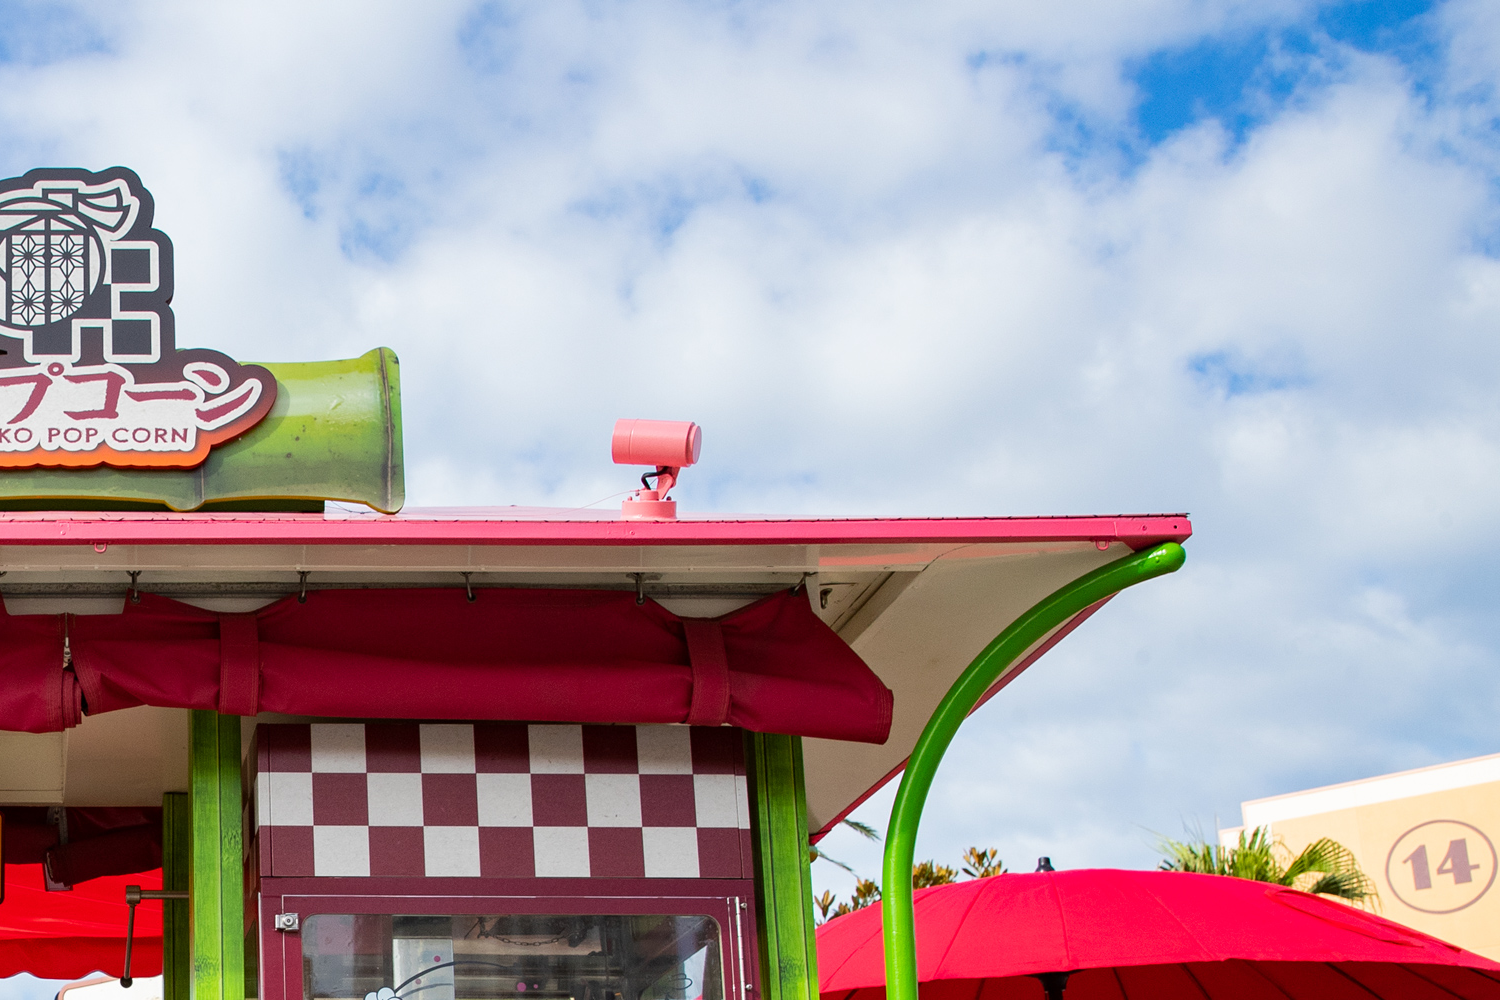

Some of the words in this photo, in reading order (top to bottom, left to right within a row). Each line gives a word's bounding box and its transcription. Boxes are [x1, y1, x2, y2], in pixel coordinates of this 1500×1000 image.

[48, 428, 98, 443] POP
[112, 428, 188, 443] CORN
[1402, 838, 1480, 890] 14
